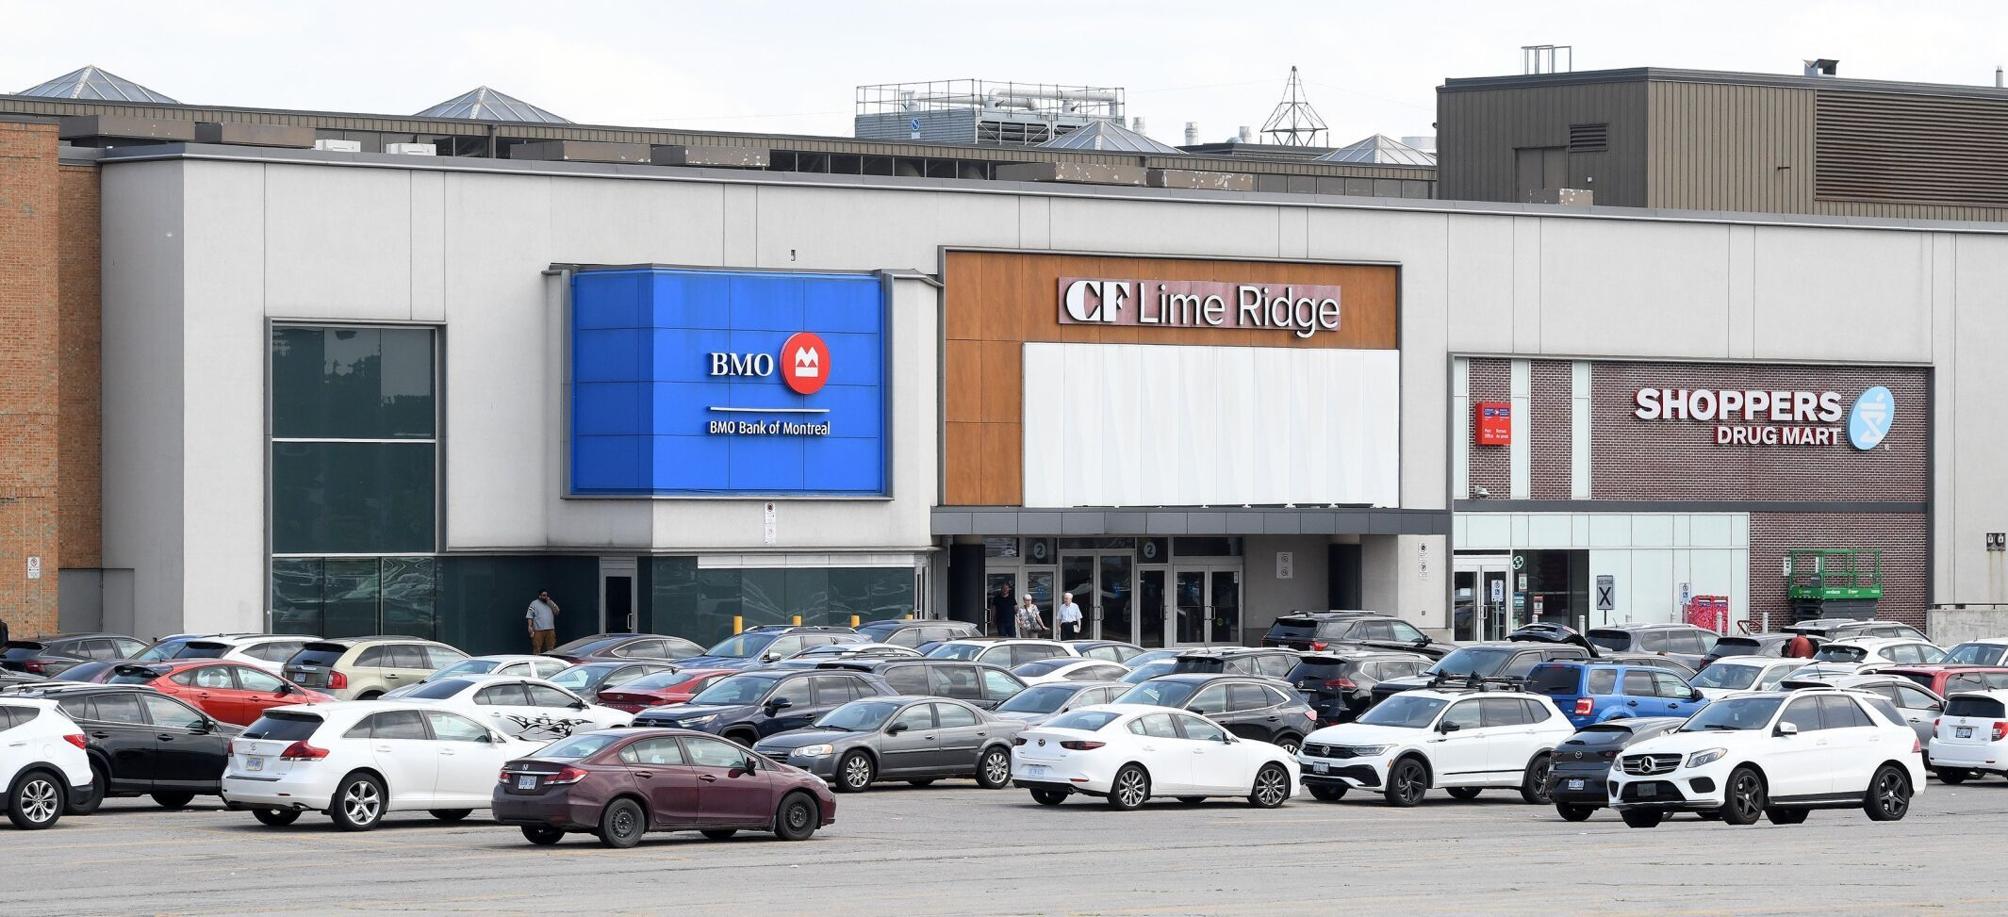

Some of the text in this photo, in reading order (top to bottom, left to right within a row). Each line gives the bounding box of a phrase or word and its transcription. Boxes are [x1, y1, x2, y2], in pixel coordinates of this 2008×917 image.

[1066, 280, 1340, 338] CF Lime Ridge
[710, 352, 774, 377] BMO
[1634, 387, 1843, 422] SHOPPERS
[710, 420, 830, 435] BMO Bank of Montreal
[1717, 426, 1842, 445] DRUG MART
[1598, 586, 1612, 607] X
